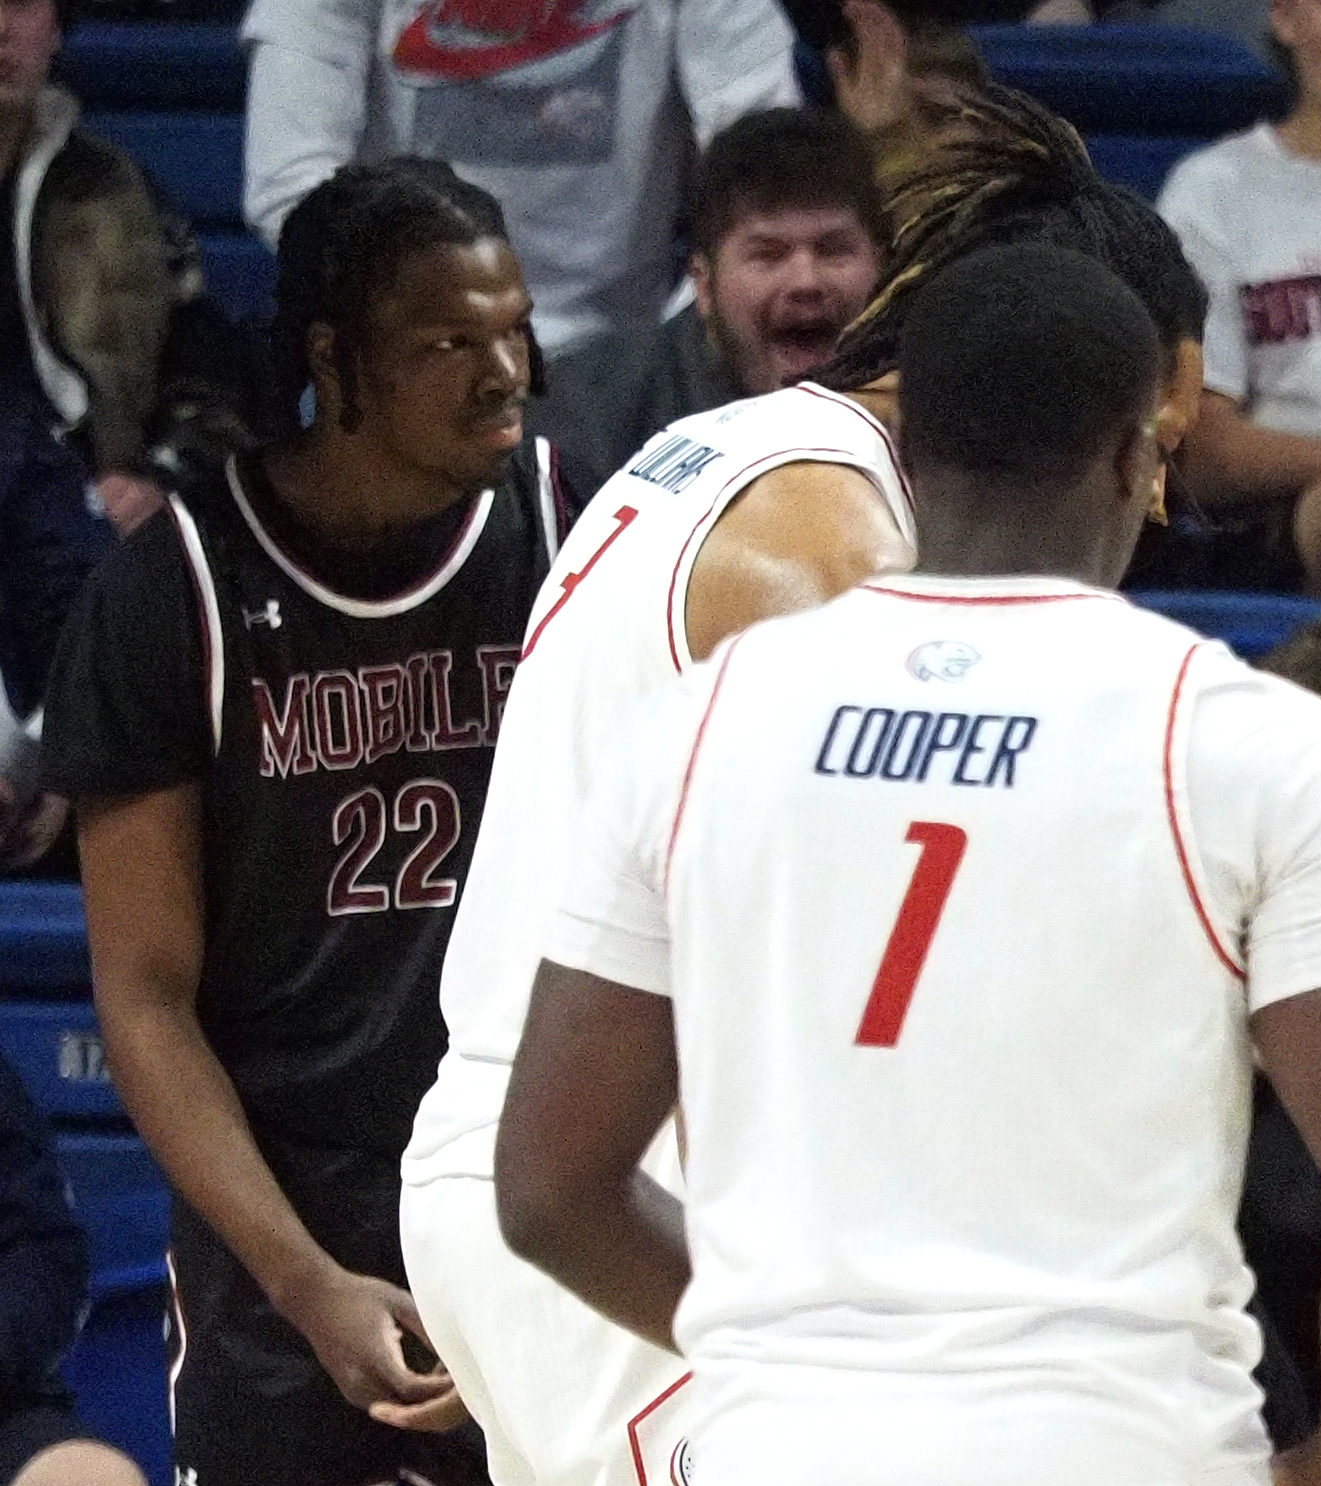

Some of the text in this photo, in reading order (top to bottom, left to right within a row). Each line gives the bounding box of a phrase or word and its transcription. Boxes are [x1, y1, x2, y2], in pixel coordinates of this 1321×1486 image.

[814, 704, 1039, 788] COOPER
[327, 777, 462, 917] 22
[854, 820, 969, 1050] 1
